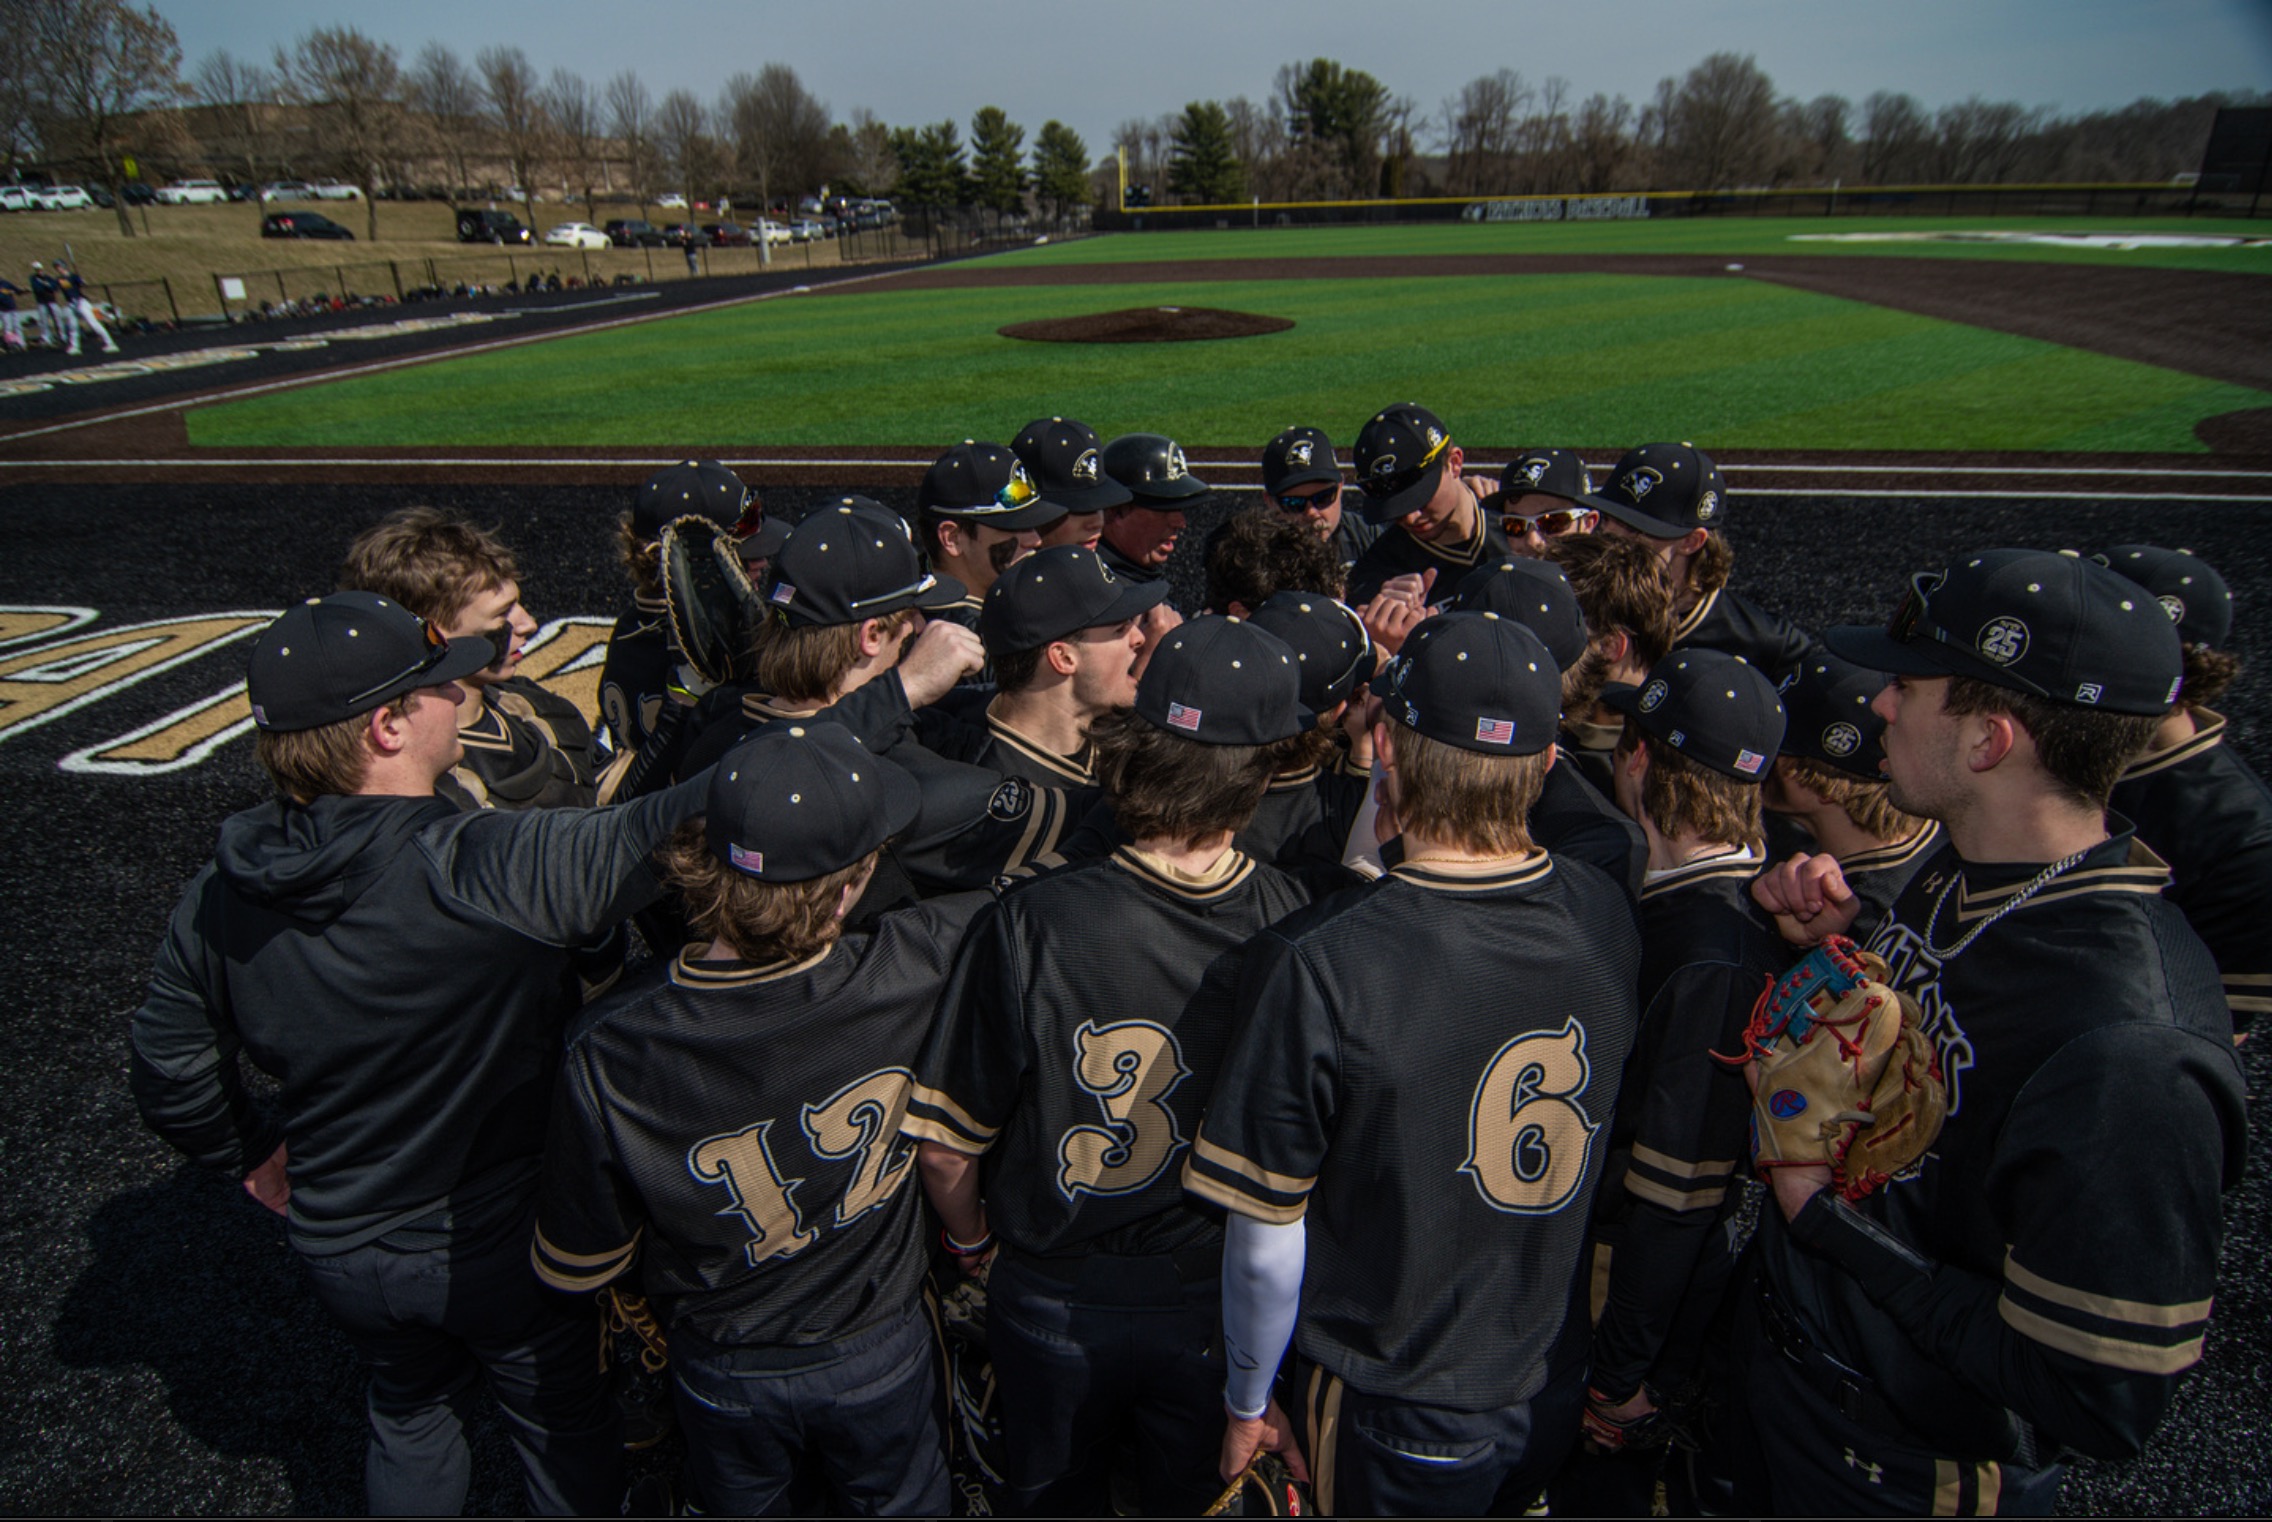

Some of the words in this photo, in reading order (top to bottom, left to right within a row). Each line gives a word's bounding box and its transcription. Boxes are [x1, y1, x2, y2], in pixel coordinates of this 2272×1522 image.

[1981, 625, 2024, 658] 25
[1825, 727, 1856, 752] 25
[689, 1066, 917, 1267] 12
[1056, 1017, 1194, 1201] 3
[1457, 1015, 1602, 1216] 6
